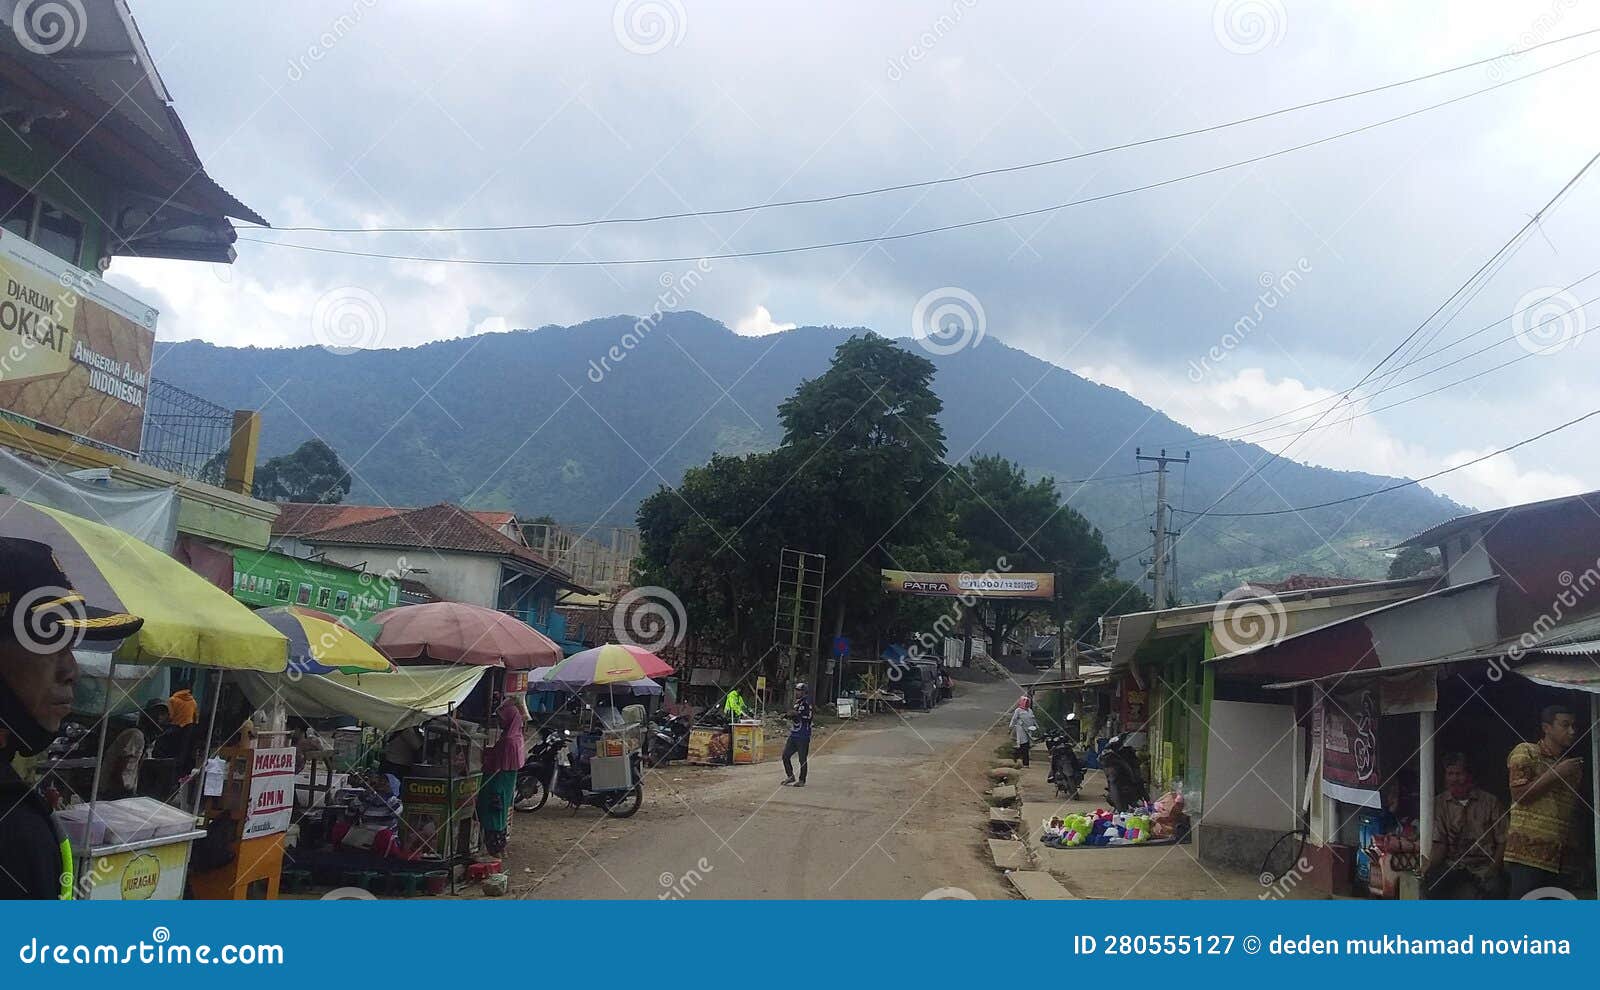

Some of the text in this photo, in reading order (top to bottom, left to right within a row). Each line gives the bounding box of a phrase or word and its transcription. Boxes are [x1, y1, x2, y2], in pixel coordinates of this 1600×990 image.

[8, 279, 54, 315] DJARUM
[122, 361, 146, 388] ALAM
[88, 369, 143, 407] INDONESIA
[903, 582, 949, 591] PATRA
[255, 754, 293, 770] MAKLOR
[124, 873, 157, 891] JURAGAN
